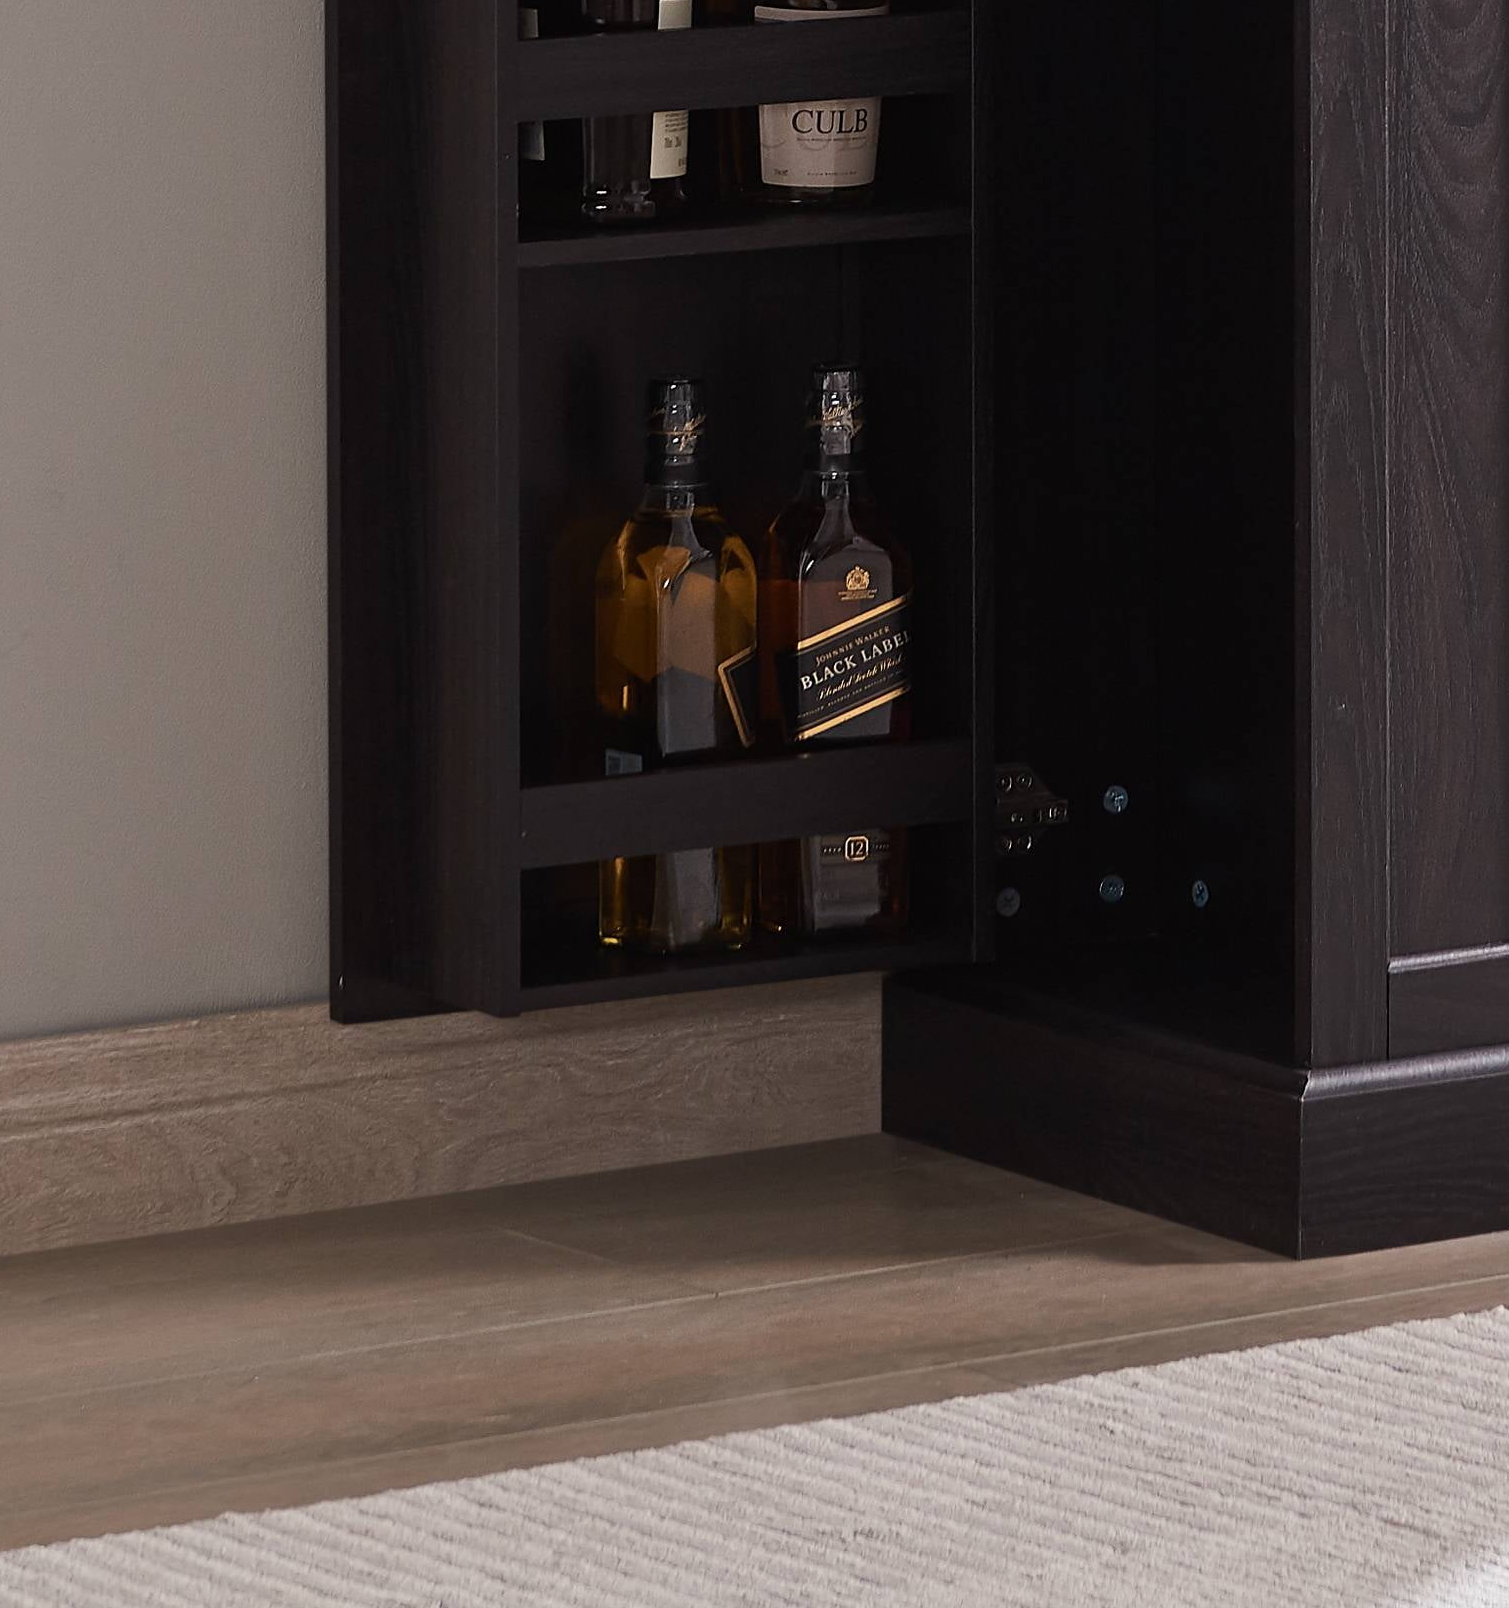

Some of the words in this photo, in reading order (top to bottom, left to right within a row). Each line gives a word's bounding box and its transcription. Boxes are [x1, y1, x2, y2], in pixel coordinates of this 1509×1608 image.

[792, 108, 868, 134] CULB
[800, 654, 857, 690] BLACK
[850, 842, 864, 856] 12
